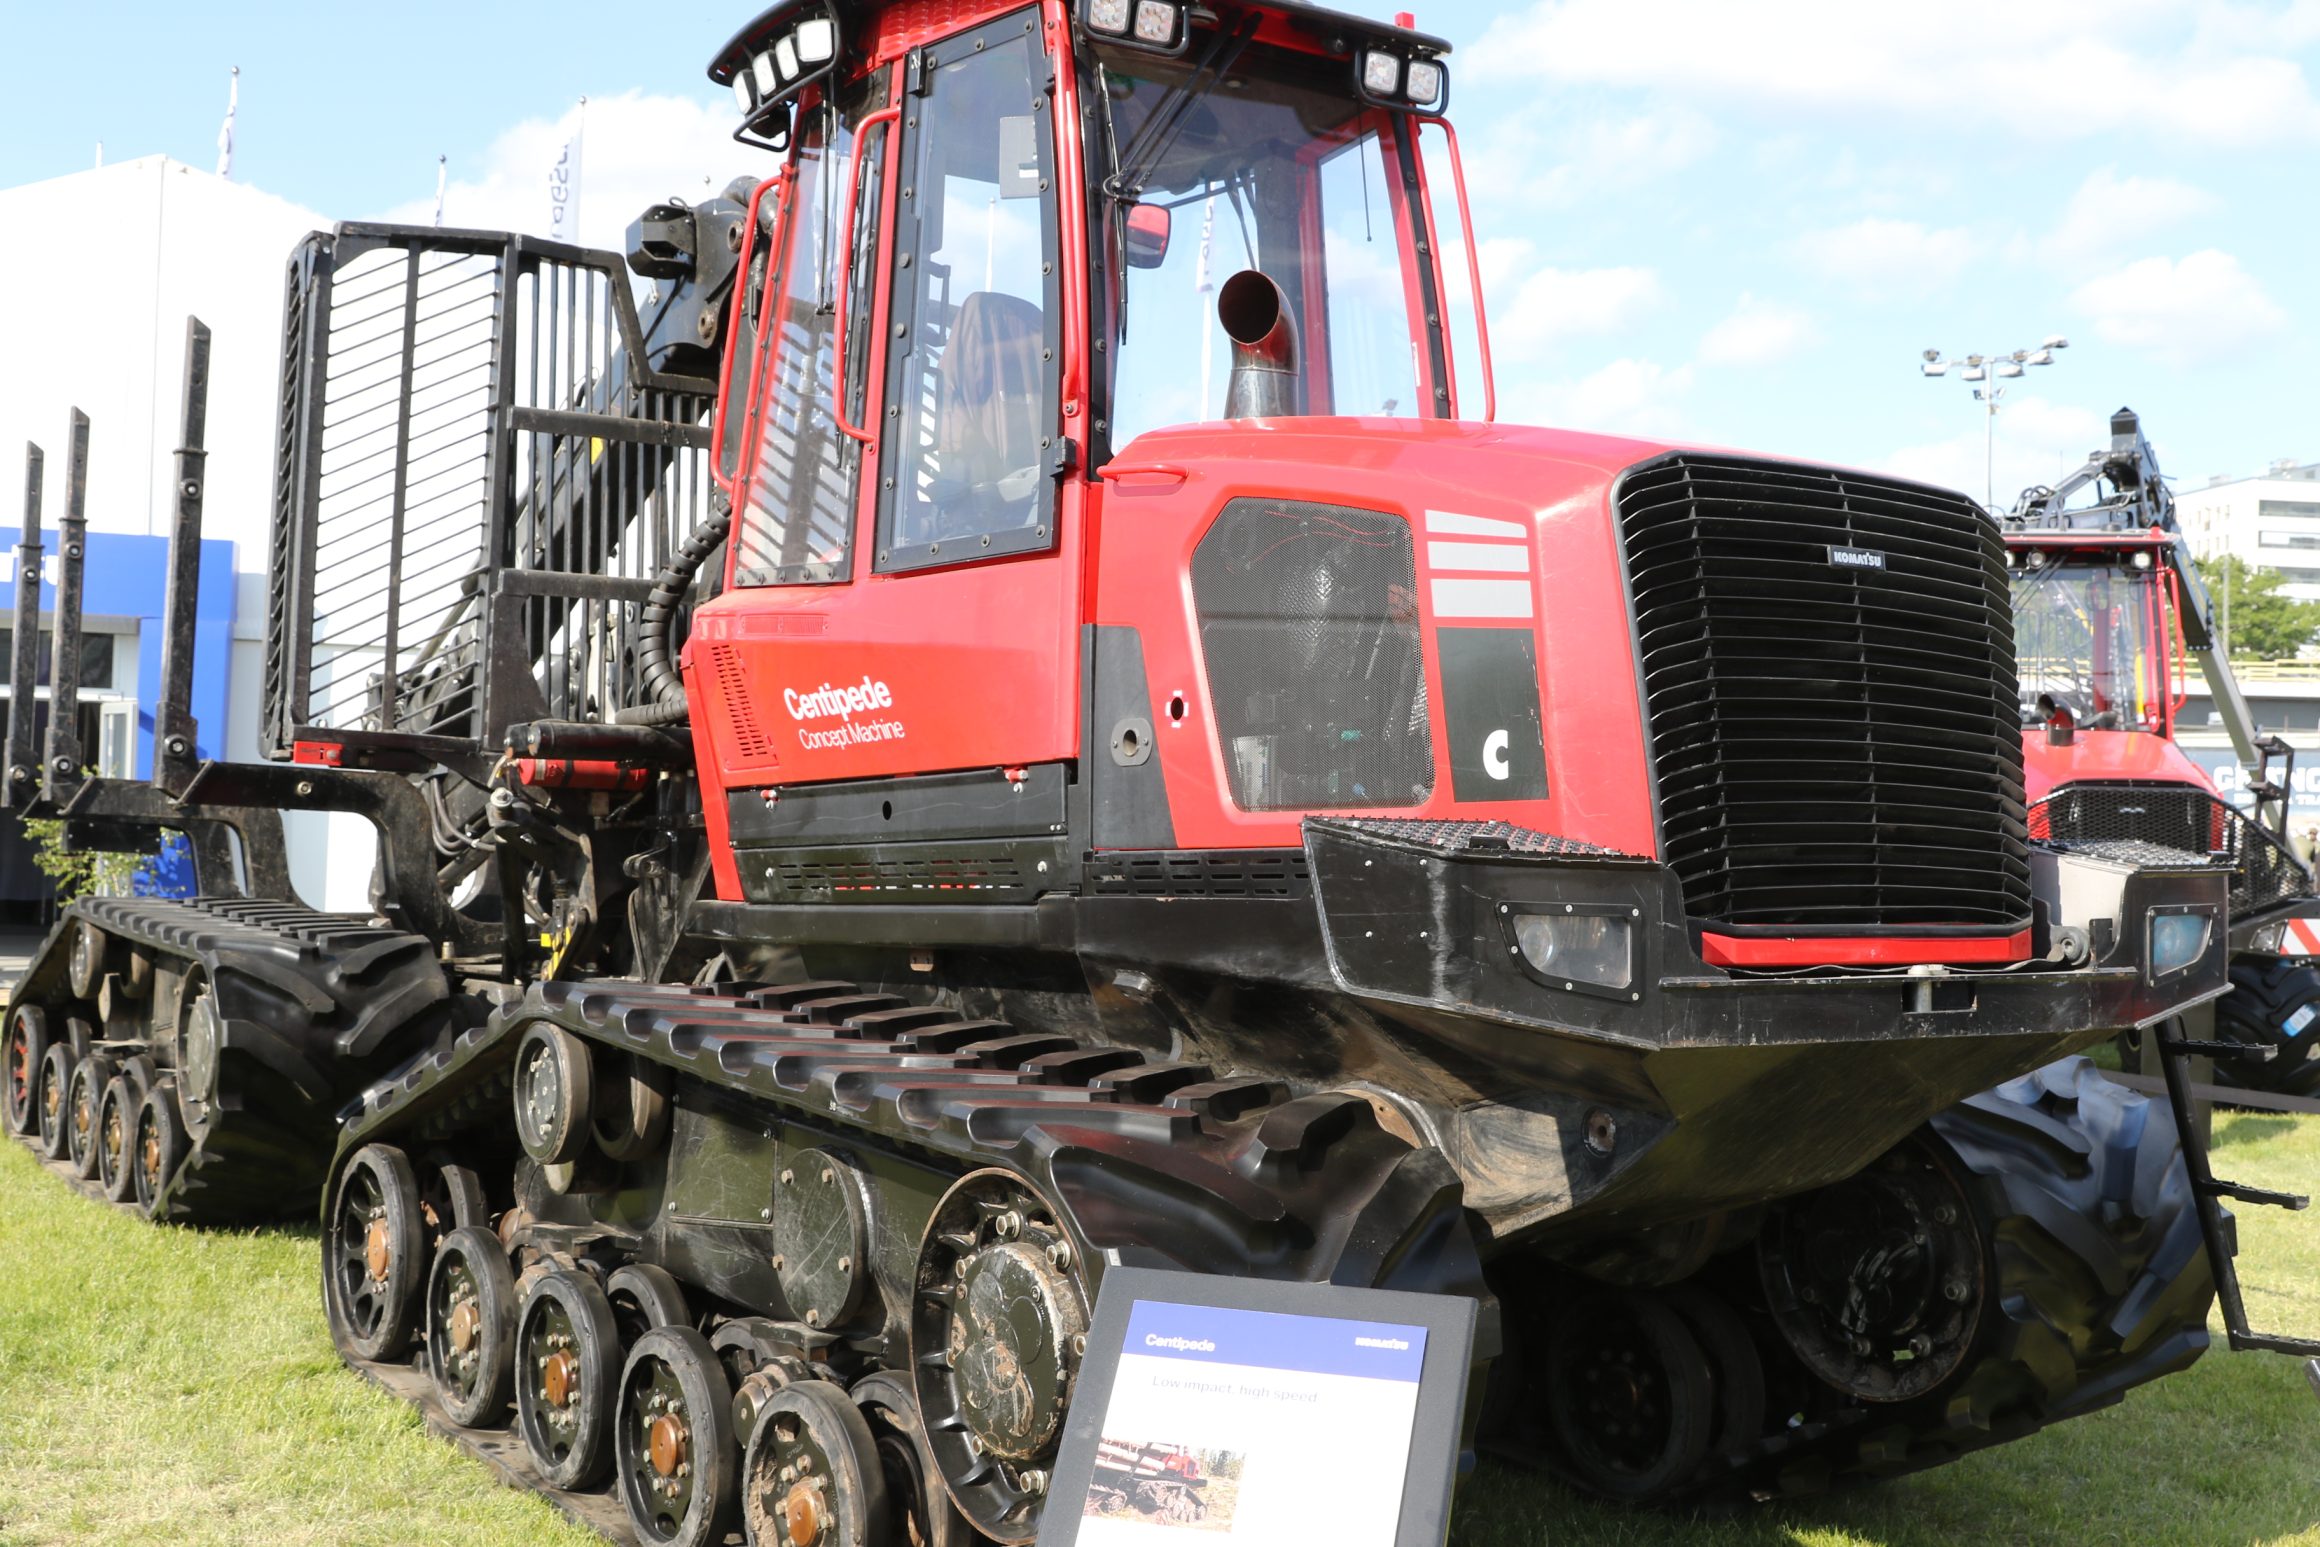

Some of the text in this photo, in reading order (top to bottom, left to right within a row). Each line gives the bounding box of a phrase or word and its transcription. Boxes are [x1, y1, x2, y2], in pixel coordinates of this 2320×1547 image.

[1834, 552, 1881, 567] KOMATSU
[783, 675, 892, 721] Centipede
[799, 718, 905, 750] Concept Machine
[1483, 729, 1509, 780] C
[1145, 1334, 1216, 1352] Centipede
[1152, 1375, 1181, 1389] Low
[1239, 1384, 1270, 1399] high
